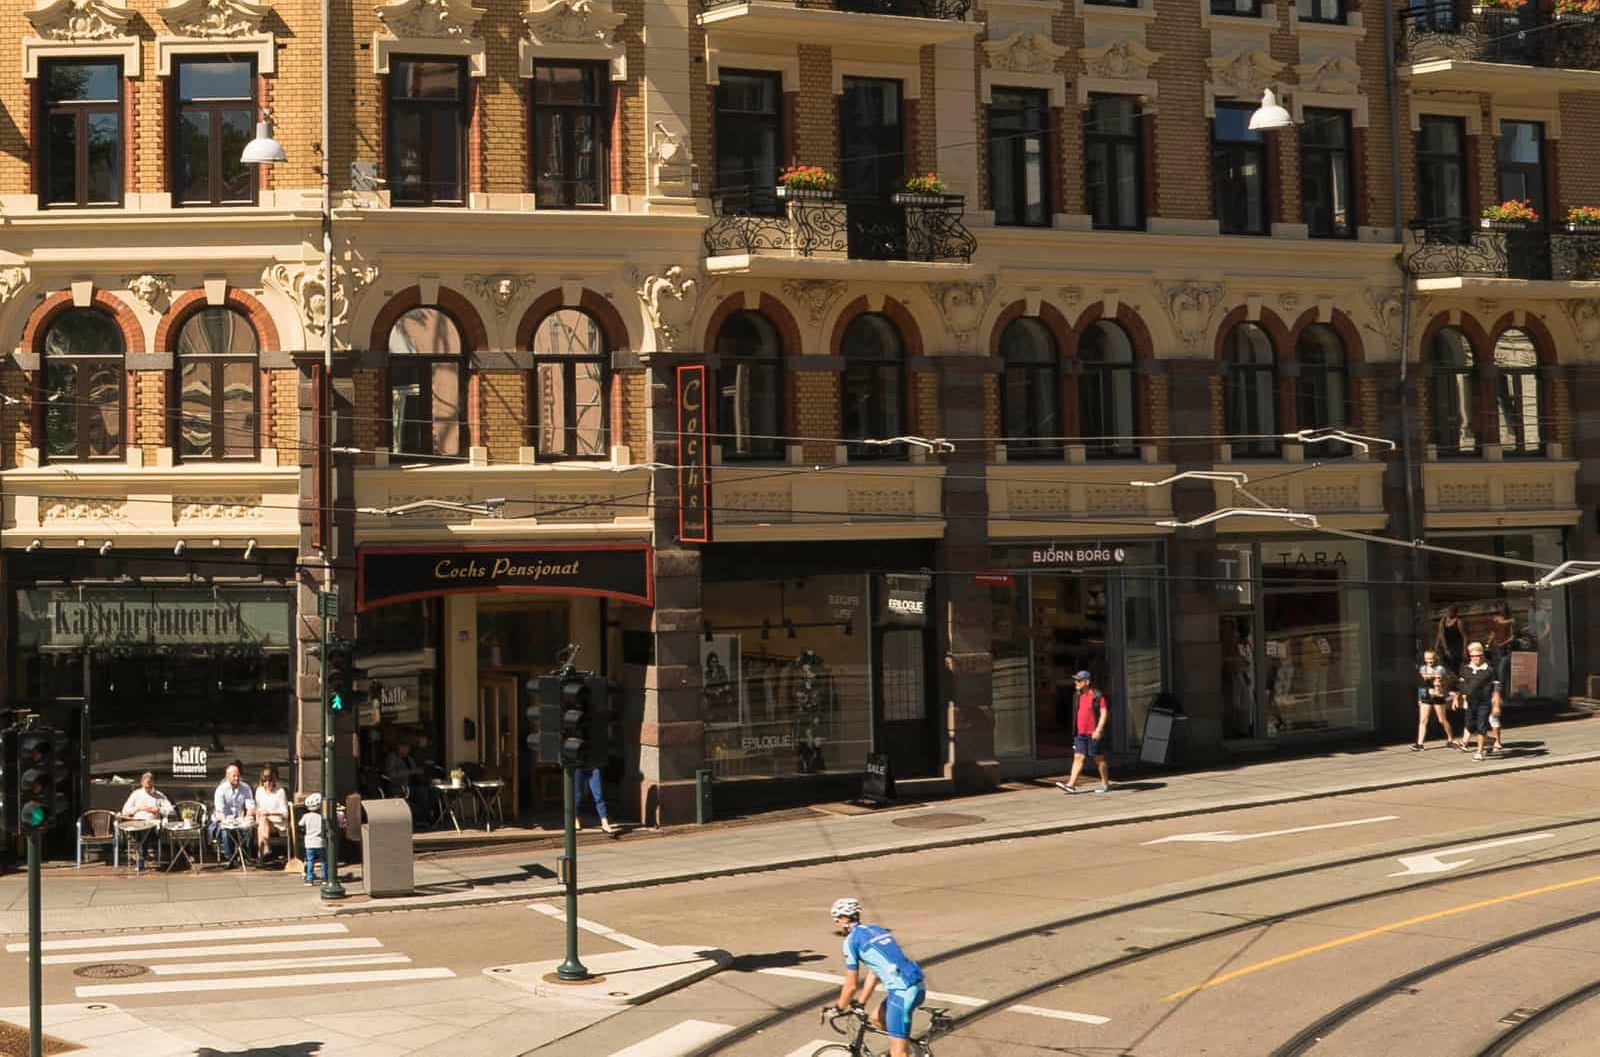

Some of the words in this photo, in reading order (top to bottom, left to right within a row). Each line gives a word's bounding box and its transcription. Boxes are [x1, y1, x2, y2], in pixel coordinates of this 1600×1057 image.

[682, 379, 701, 509] Cochs
[1076, 549, 1110, 561] BORG
[1277, 551, 1347, 567] TARA
[435, 559, 486, 578] Cochs
[491, 557, 580, 580] Pensjonat
[172, 746, 207, 764] Kaffe
